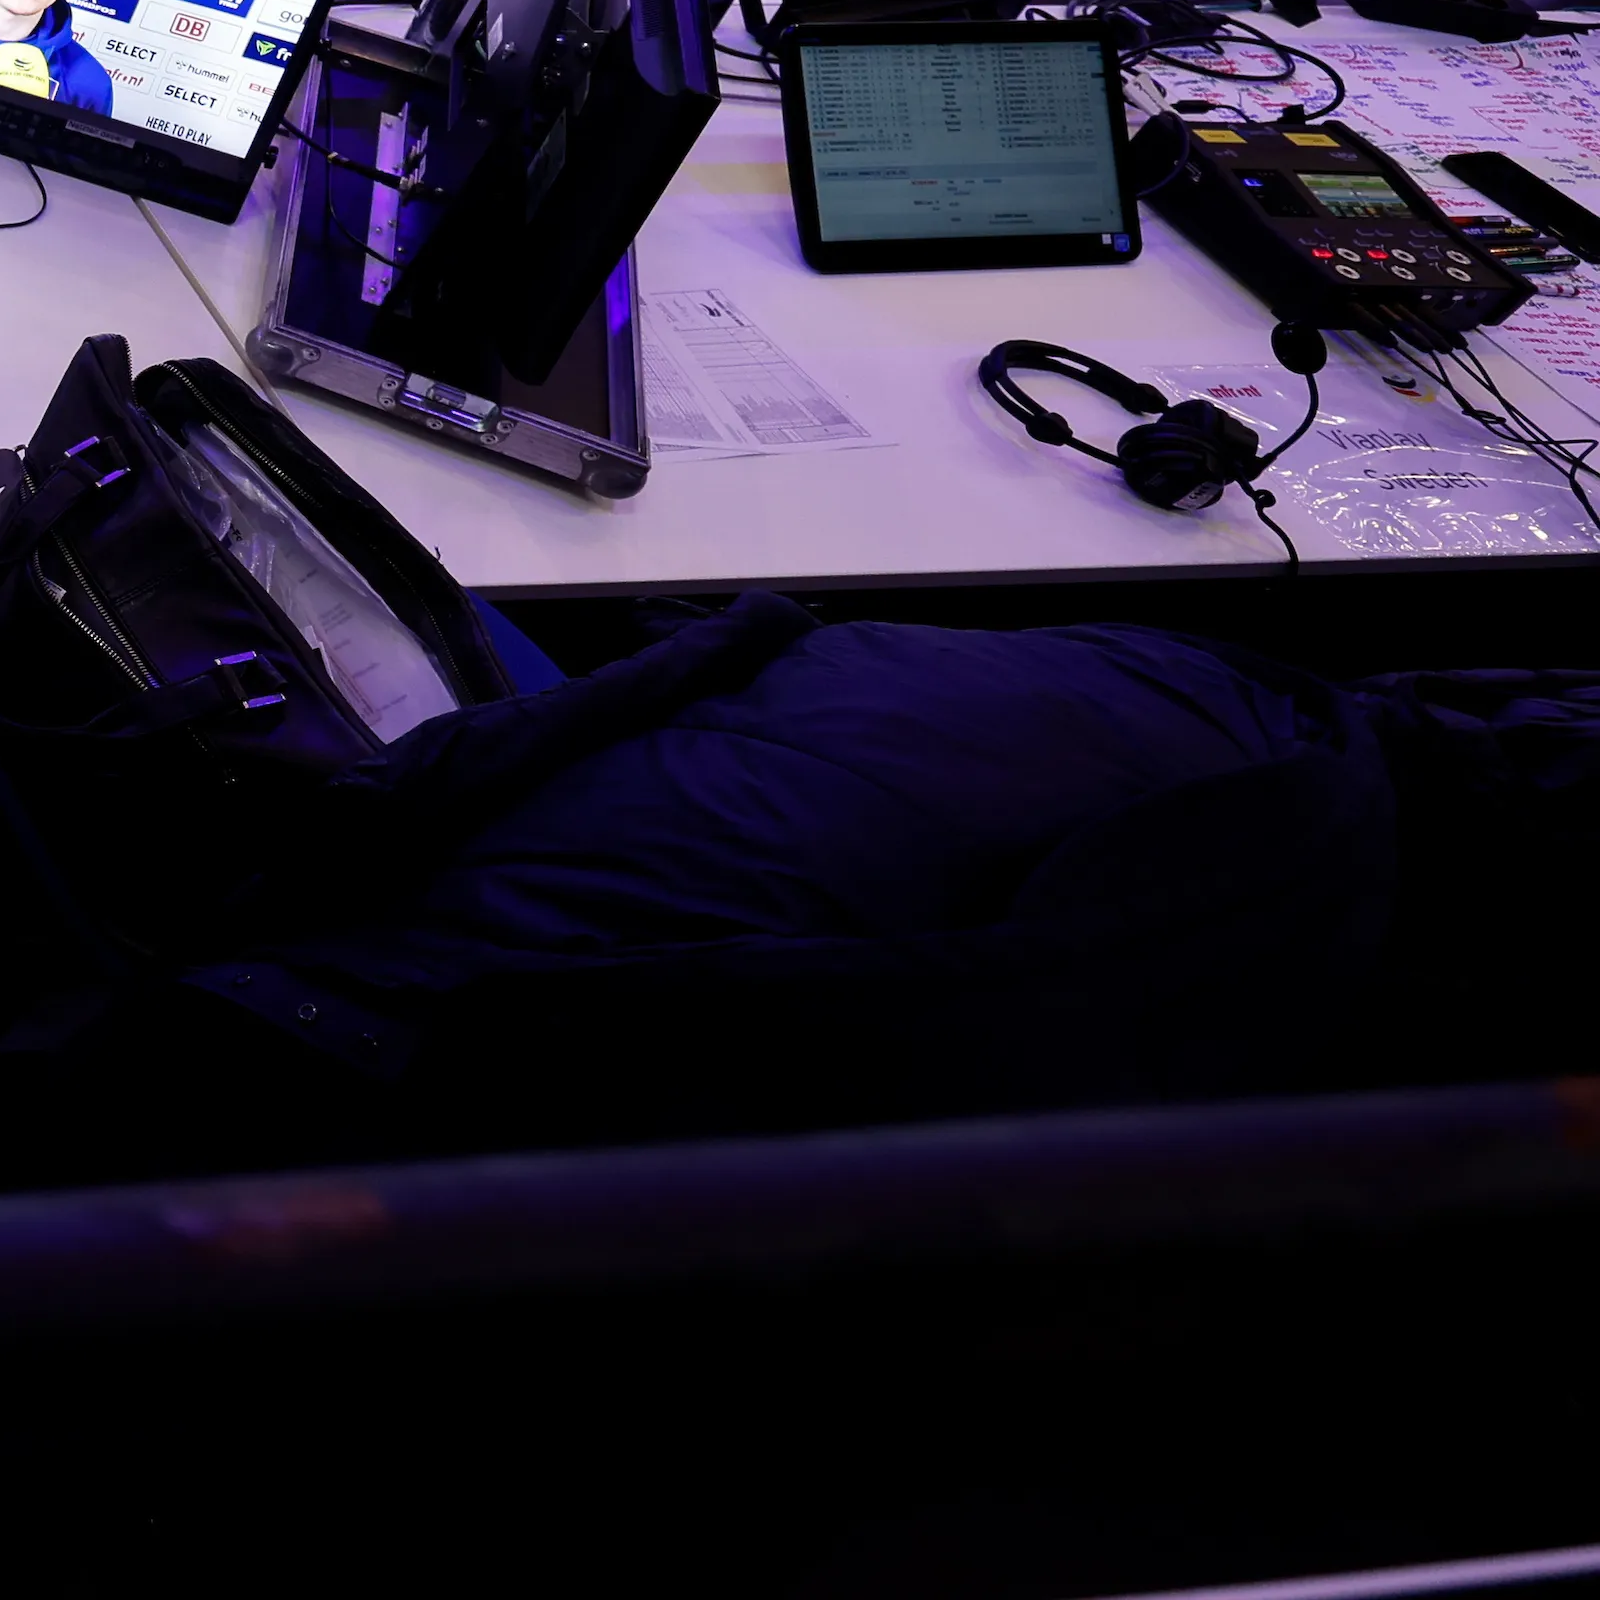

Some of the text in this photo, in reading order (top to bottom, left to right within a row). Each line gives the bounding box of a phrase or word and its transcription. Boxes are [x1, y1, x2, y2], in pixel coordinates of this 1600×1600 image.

[175, 17, 204, 38] DB
[105, 38, 157, 63] SELECT
[187, 62, 231, 84] hummel
[164, 84, 218, 110] SELECT
[145, 115, 213, 147] HERE TO PLAY
[1316, 428, 1436, 454] Viaplay
[1362, 467, 1489, 492] Sweden
